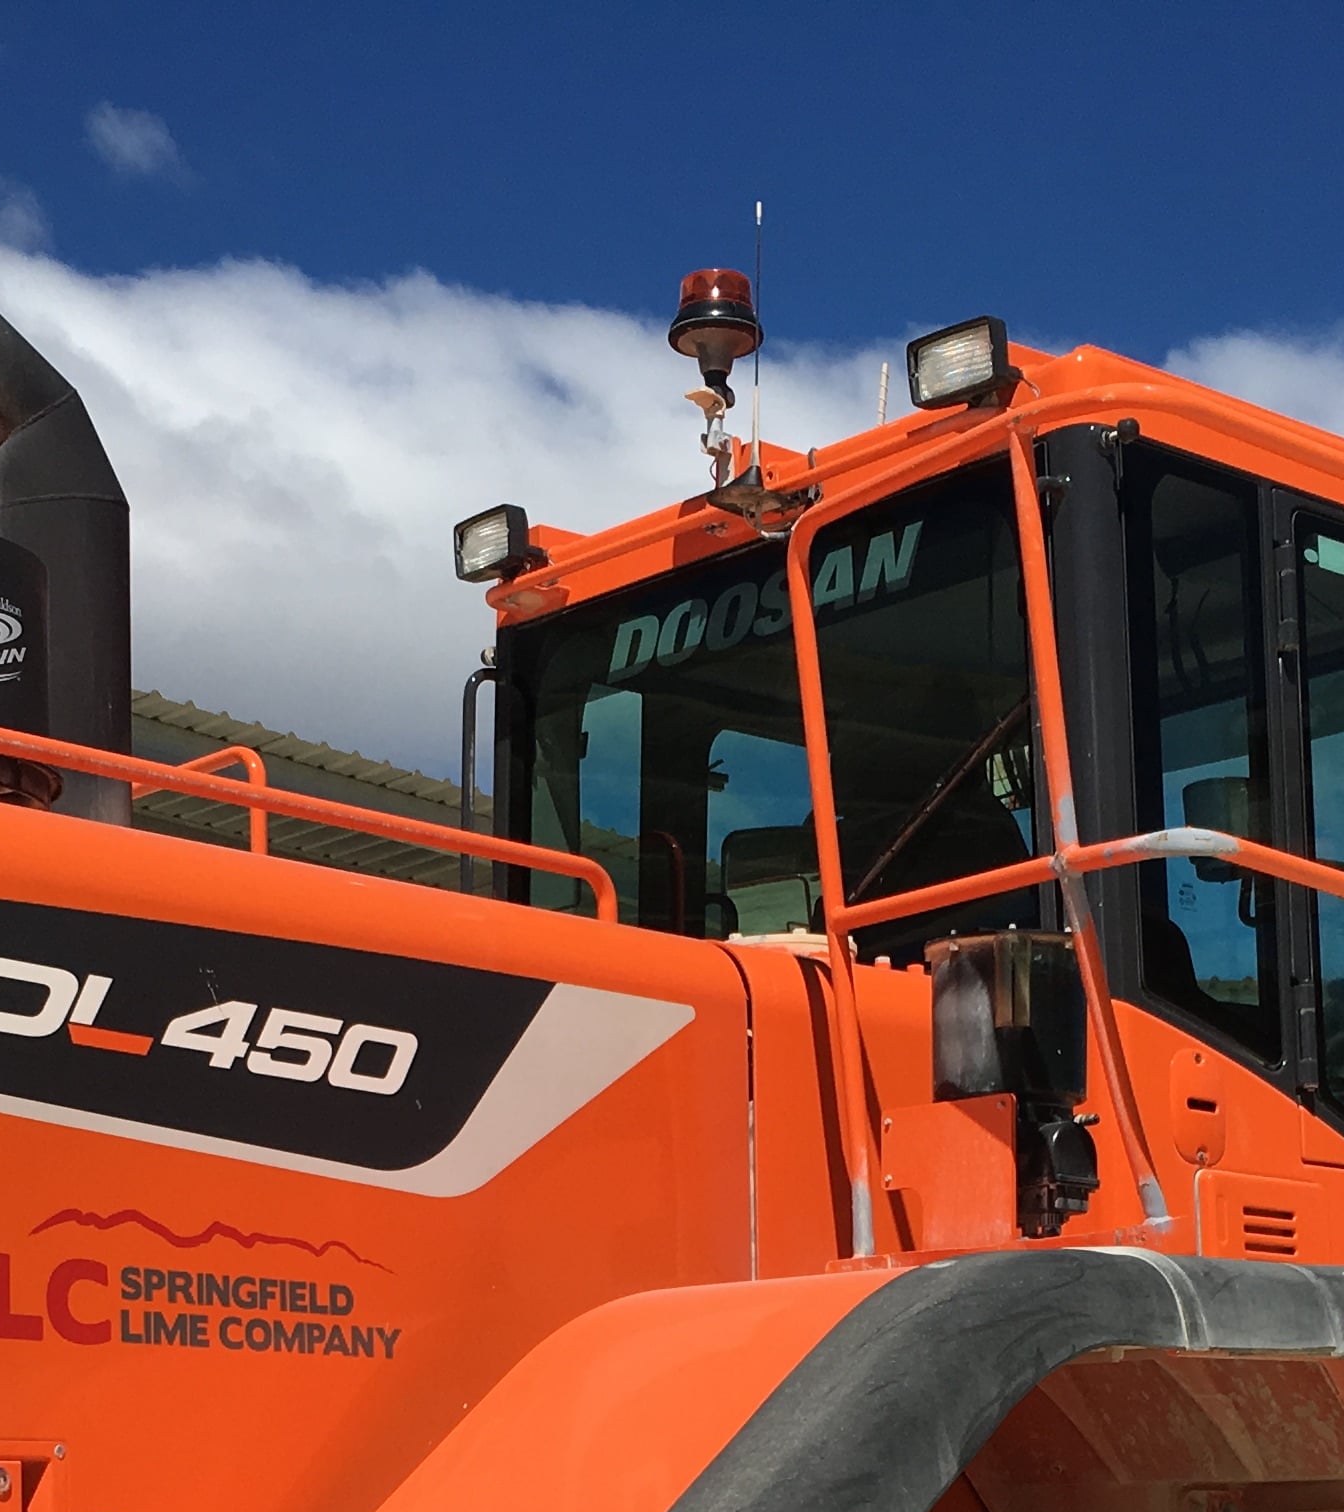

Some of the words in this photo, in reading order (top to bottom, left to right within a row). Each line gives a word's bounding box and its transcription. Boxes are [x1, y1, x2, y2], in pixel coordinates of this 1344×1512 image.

[607, 520, 924, 685] DOOSAN
[120, 1266, 354, 1316] SPRINGFIELD
[120, 1309, 210, 1349] LIME
[219, 1316, 402, 1360] COMPANY
